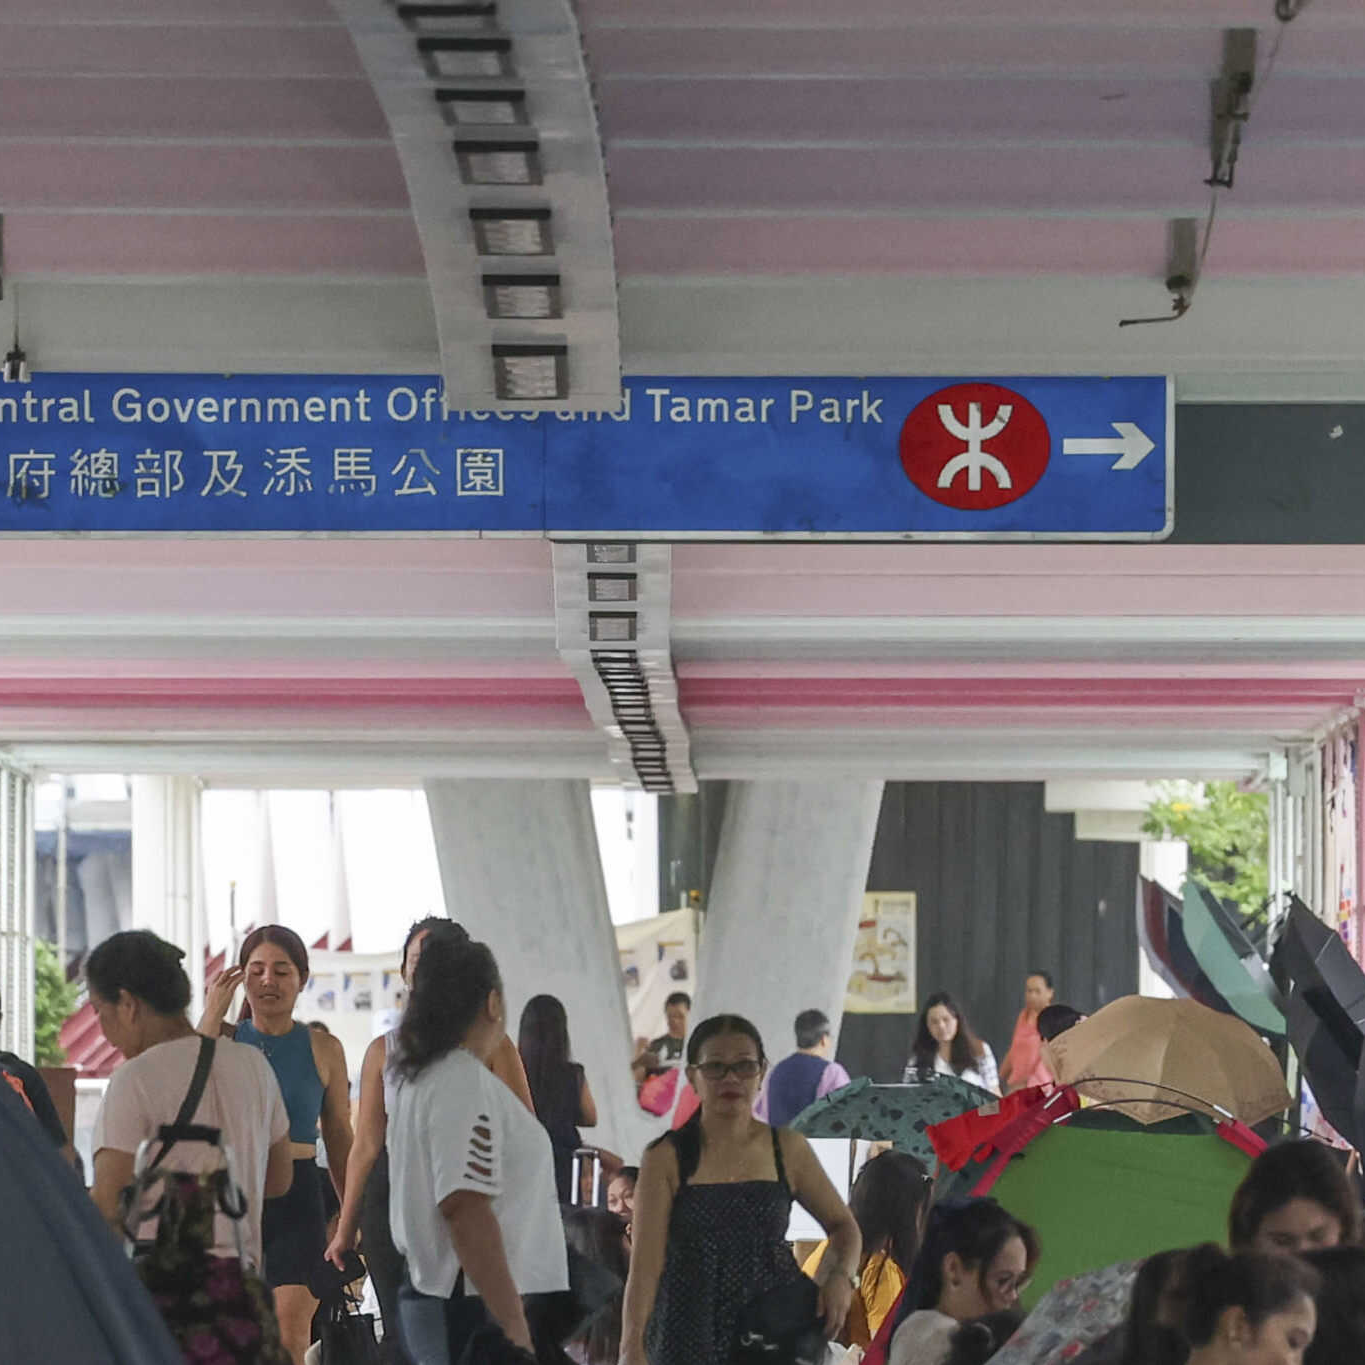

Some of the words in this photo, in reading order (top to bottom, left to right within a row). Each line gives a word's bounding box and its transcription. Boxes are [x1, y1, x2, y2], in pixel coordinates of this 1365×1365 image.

[111, 388, 371, 423] Government
[645, 388, 775, 424] Tamar
[790, 390, 884, 424] Park
